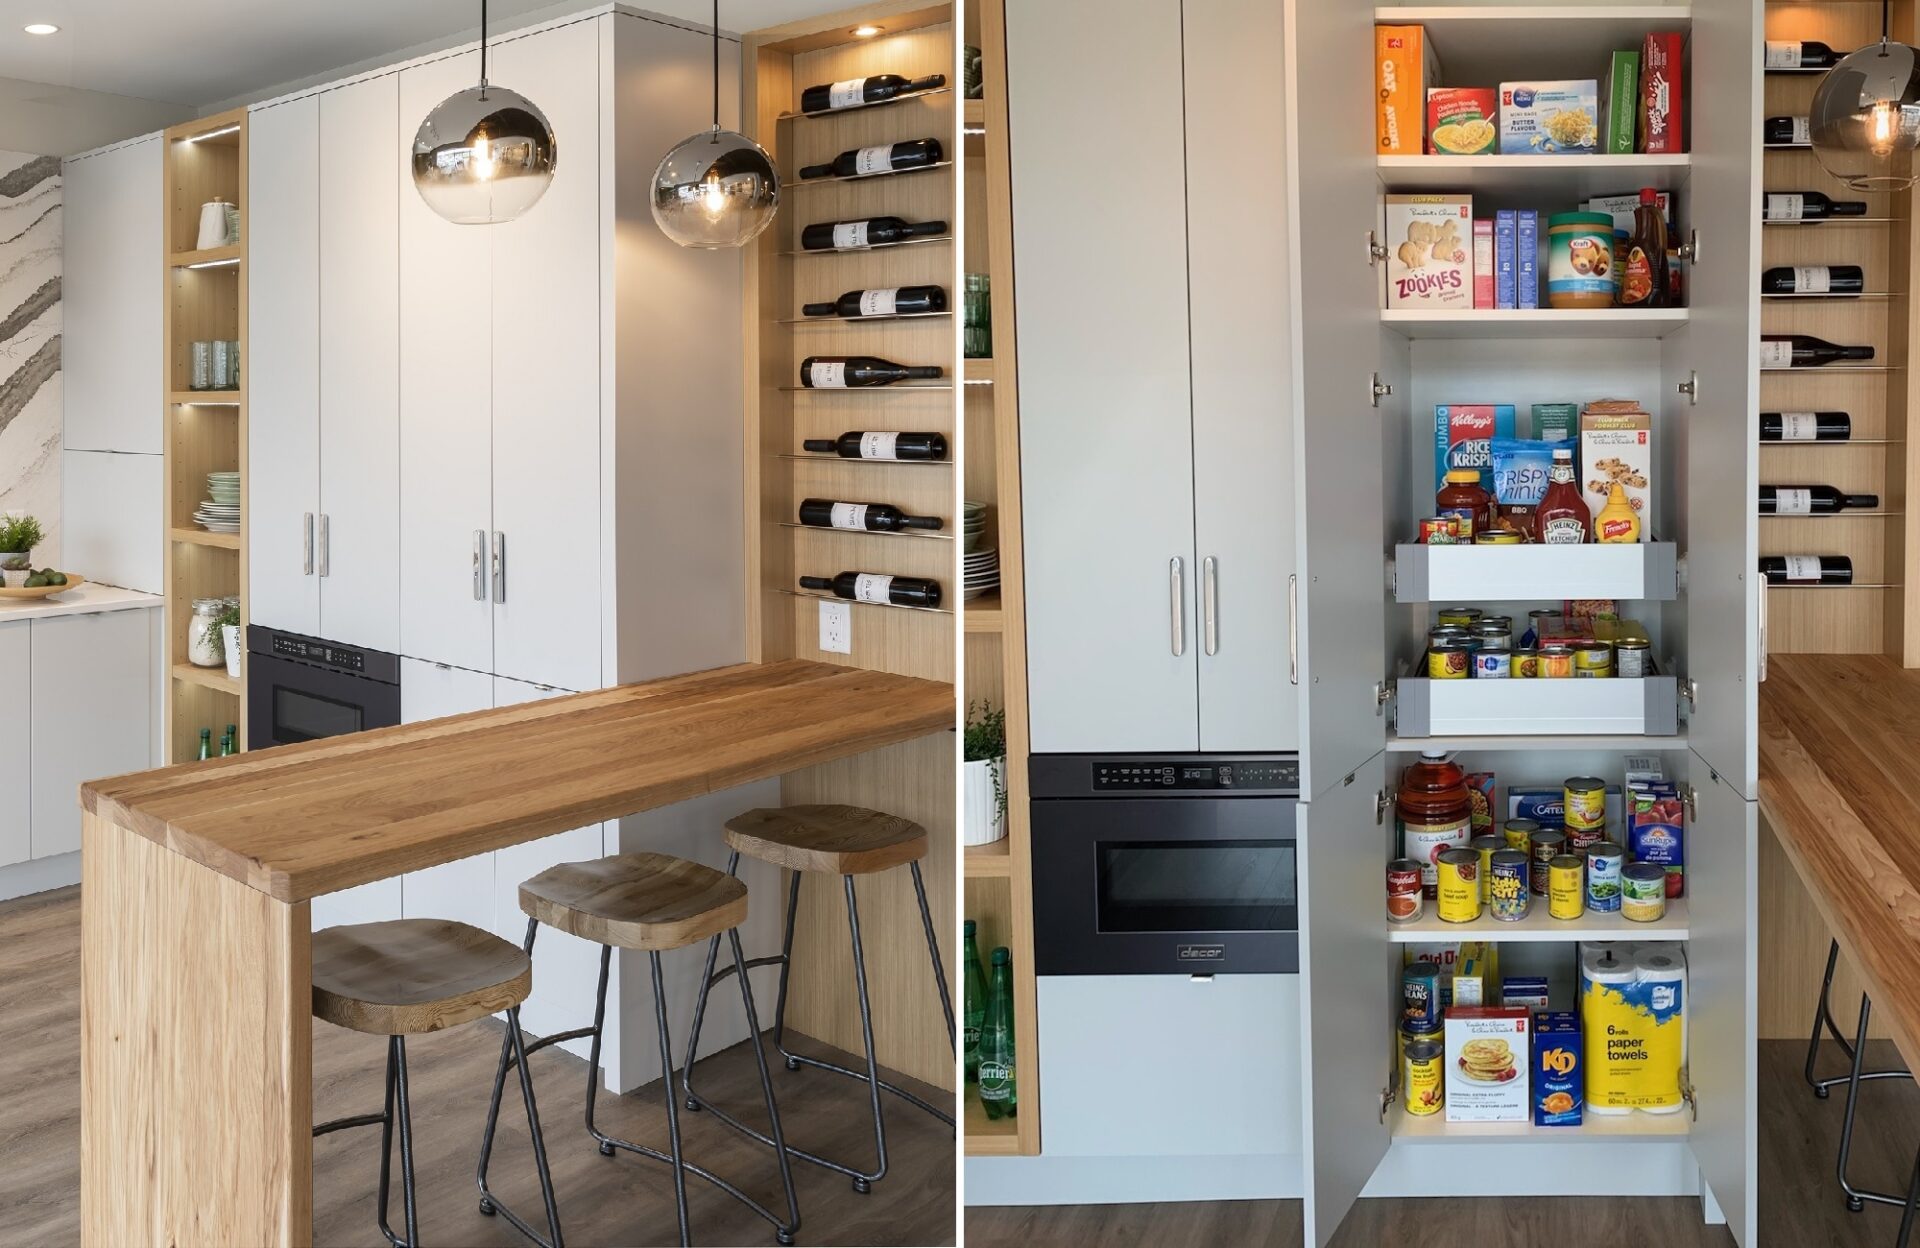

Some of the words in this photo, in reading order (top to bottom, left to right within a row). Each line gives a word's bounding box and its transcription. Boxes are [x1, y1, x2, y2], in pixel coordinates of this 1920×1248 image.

[1573, 240, 1589, 248] Kraft
[1396, 270, 1462, 299] ZOOKIES
[1451, 413, 1492, 428] Kellogg's
[1437, 407, 1448, 449] JUMBO
[1465, 441, 1490, 454] RICE
[1453, 453, 1493, 467] KRISPI
[1553, 521, 1576, 530] HEINZ
[1537, 805, 1564, 814] CATEL
[1406, 983, 1425, 992] HEINZ
[1405, 990, 1428, 1000] BEANS
[1607, 1025, 1615, 1035] 6
[1608, 1039, 1644, 1050] paper
[1607, 1049, 1648, 1060] towels
[1543, 1048, 1576, 1076] KD
[1544, 1083, 1573, 1091] ORIGINAL
